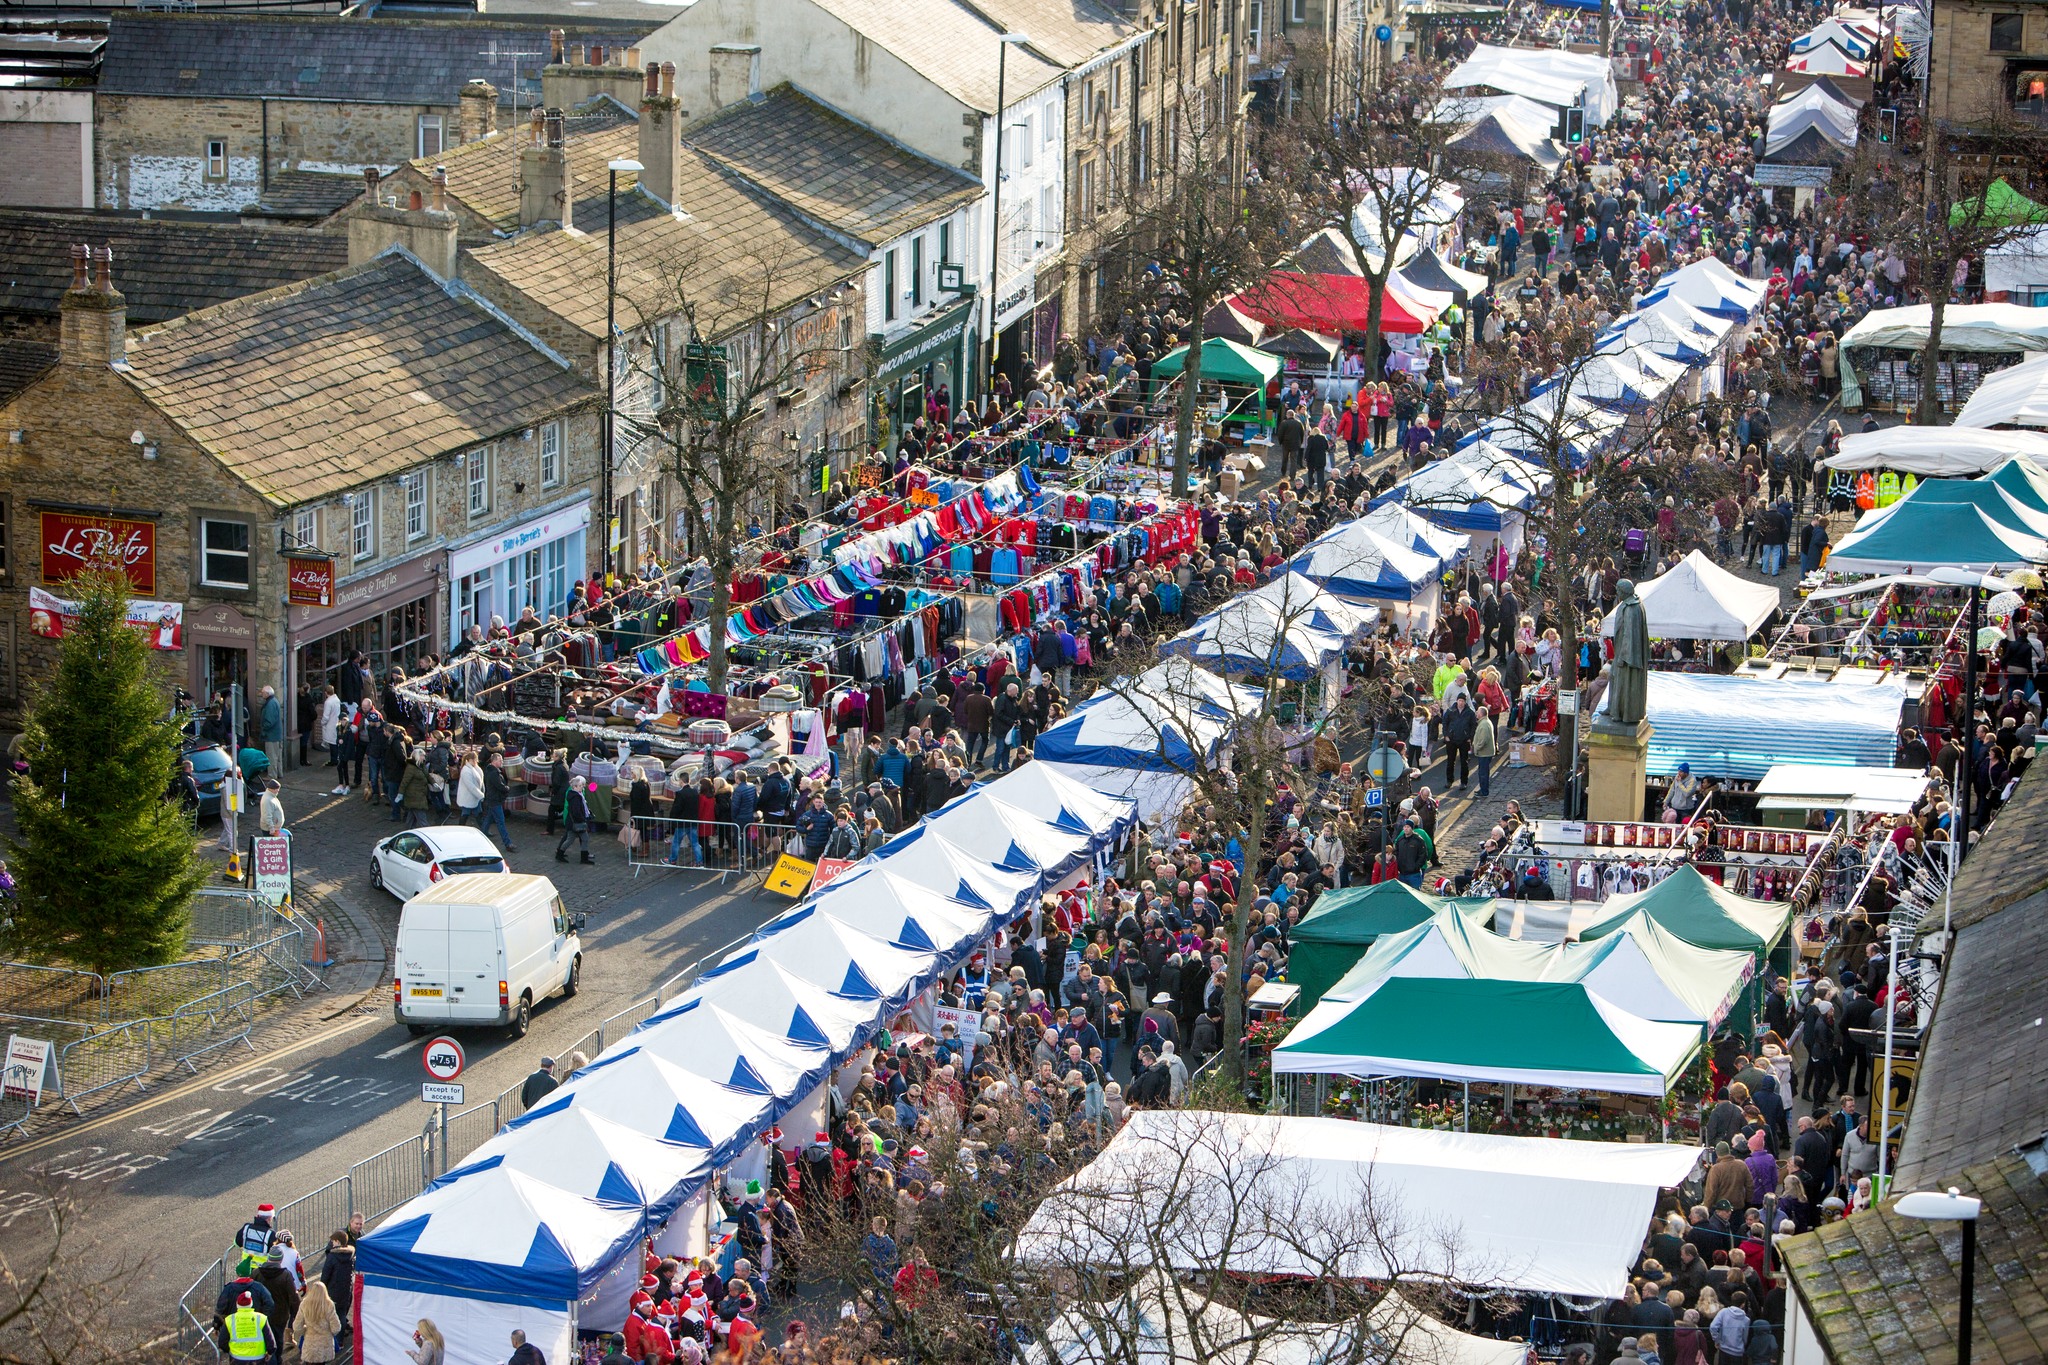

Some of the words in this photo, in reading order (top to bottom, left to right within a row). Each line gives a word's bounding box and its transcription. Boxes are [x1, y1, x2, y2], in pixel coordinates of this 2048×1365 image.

[816, 307, 838, 338] LION
[884, 344, 922, 374] MOUNTAIN
[920, 321, 964, 357] WAREHOUSE
[1305, 361, 1329, 369] PUDDIN
[49, 528, 88, 561] Le
[80, 528, 148, 565] Bistro
[337, 585, 368, 606] Chocolates
[375, 572, 398, 591] Truffles
[192, 622, 221, 632] Chocolates
[229, 626, 250, 636] Truffles
[1372, 791, 1380, 804] P
[780, 860, 811, 877] Diversion
[262, 880, 287, 889] Today
[438, 1055, 450, 1065] 7.5
[211, 1066, 412, 1108] COACH
[424, 1085, 448, 1093] Except
[450, 1086, 461, 1094] for
[132, 1108, 276, 1142] AND
